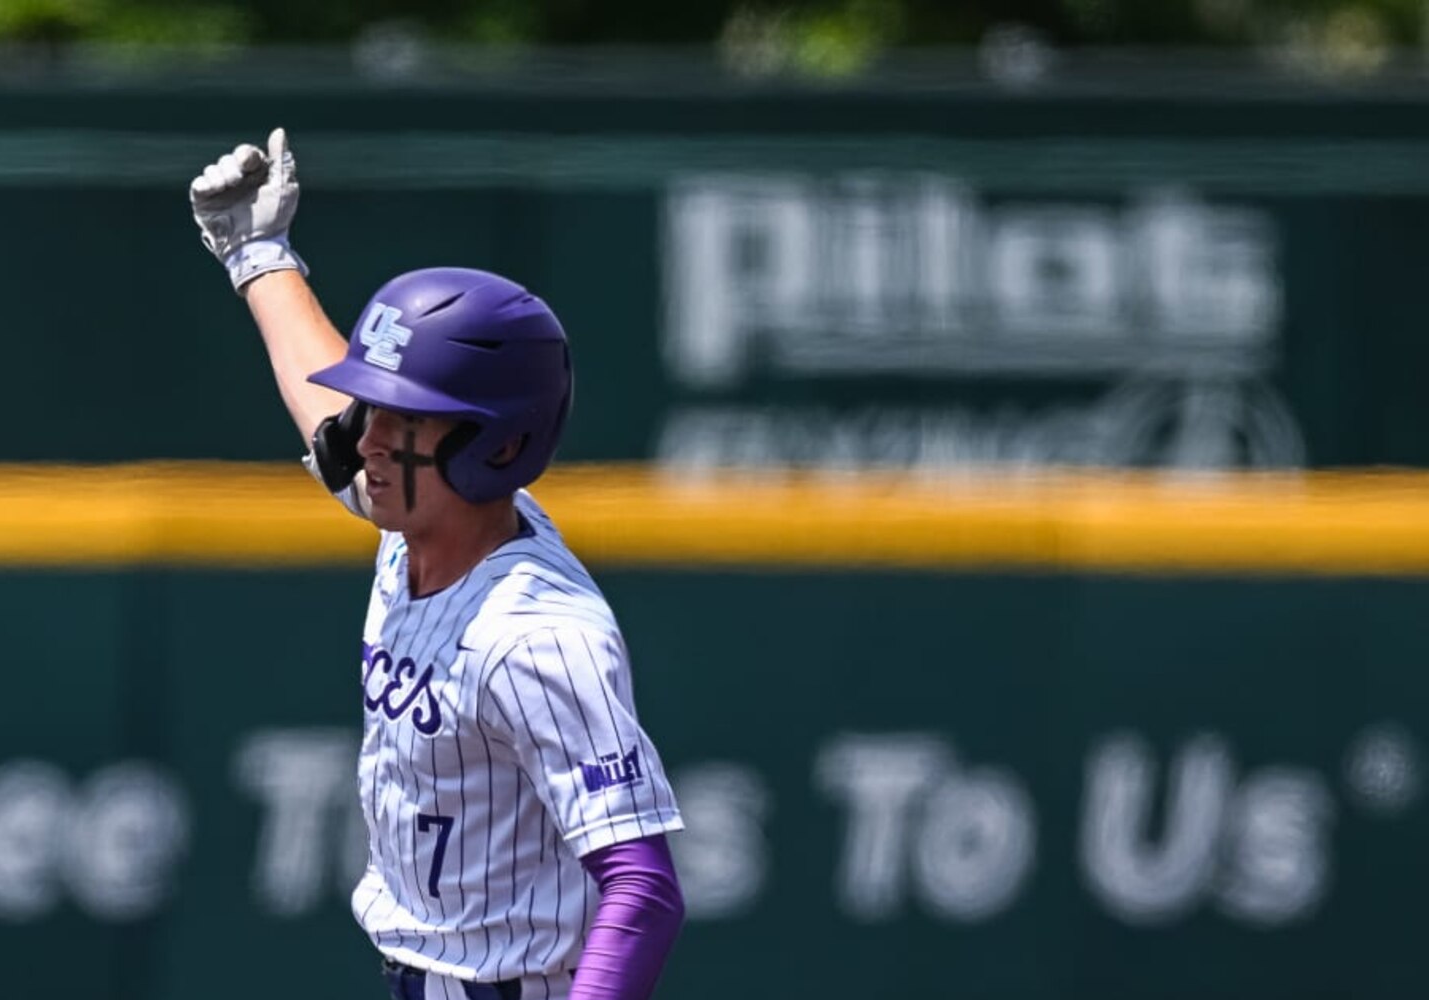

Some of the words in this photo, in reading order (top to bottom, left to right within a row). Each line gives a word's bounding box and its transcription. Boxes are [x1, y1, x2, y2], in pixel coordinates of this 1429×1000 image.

[577, 745, 642, 793] VALLEY
[417, 813, 454, 898] 7
[814, 732, 1035, 922] To
[1083, 730, 1330, 926] Us
